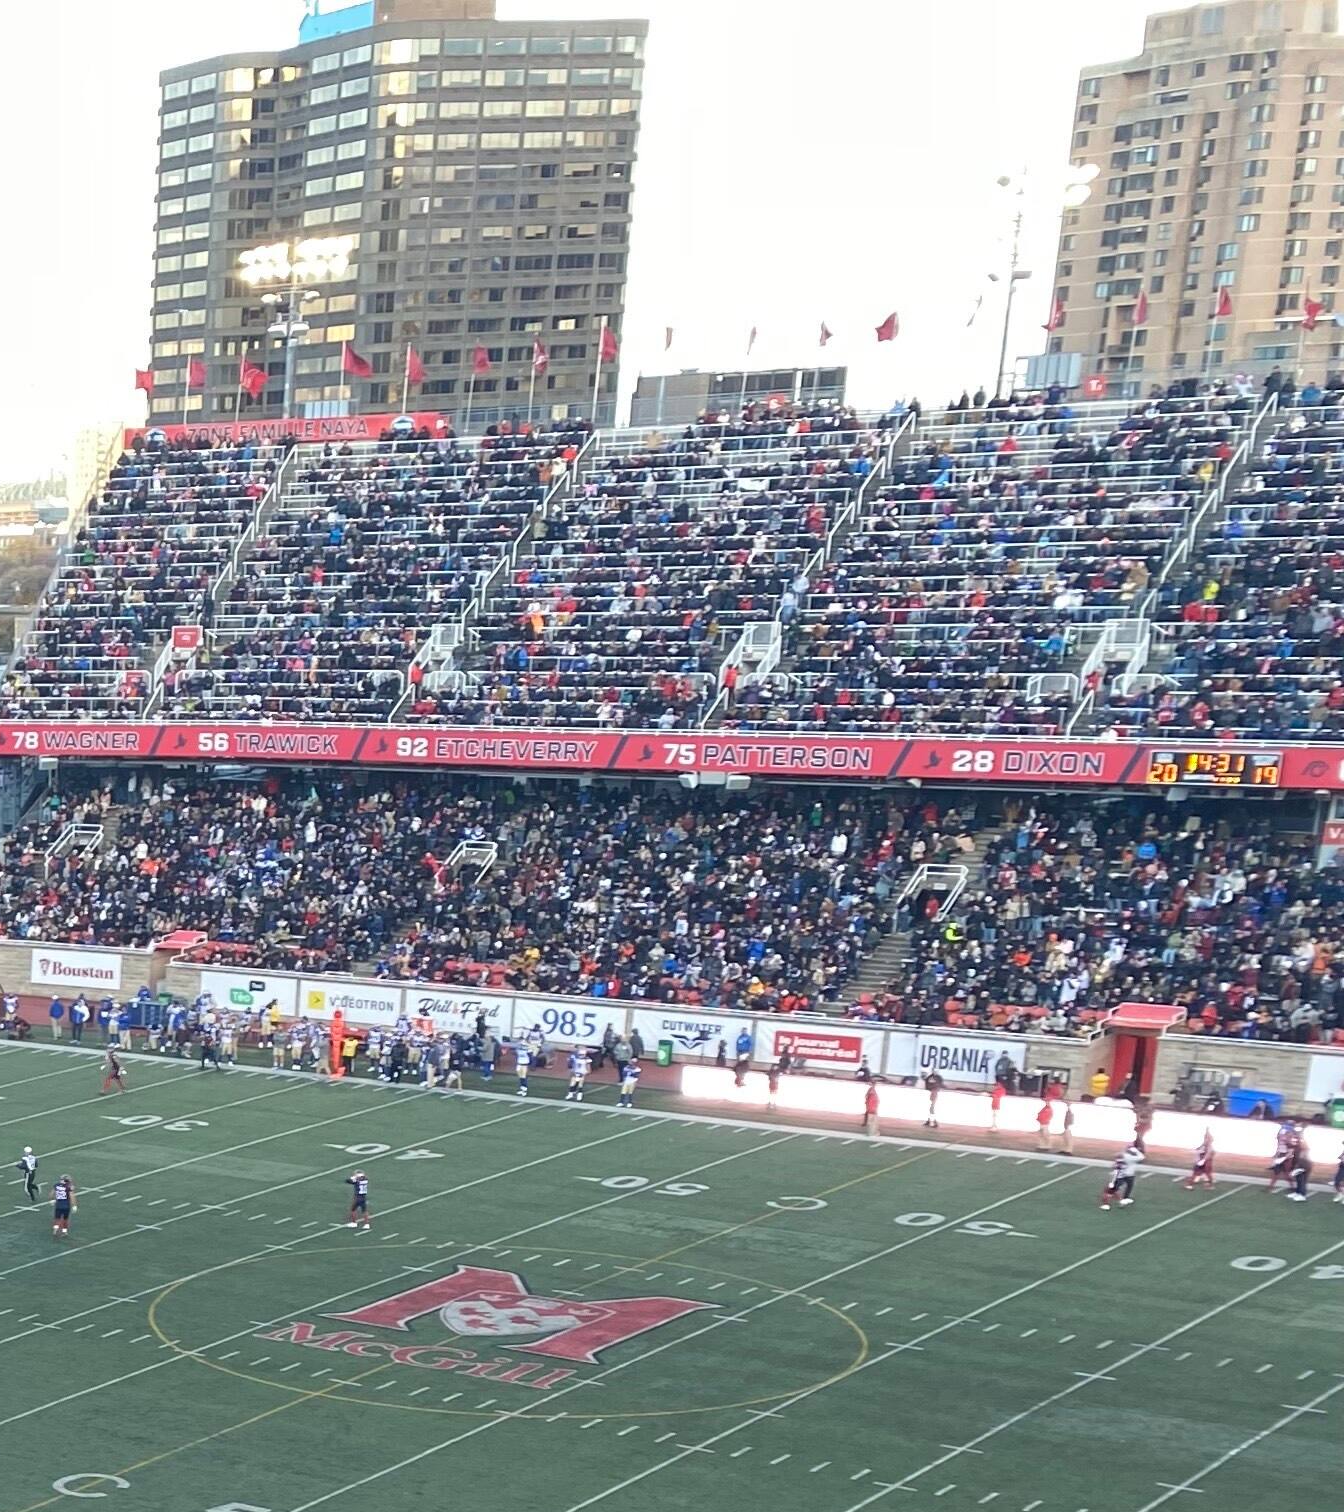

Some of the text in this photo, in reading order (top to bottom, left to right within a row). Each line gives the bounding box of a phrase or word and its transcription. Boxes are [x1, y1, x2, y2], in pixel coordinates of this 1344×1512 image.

[320, 419, 369, 436] NAYA
[12, 731, 140, 751] 78 WAGNER
[198, 732, 339, 755] 56 TRAWICK
[396, 737, 598, 763] 92 ETCHEVERRY
[663, 743, 872, 769] 75 PATTERSON
[952, 750, 1105, 776] 28 DIXON
[1184, 753, 1246, 773] 14:31
[1146, 763, 1179, 783] 20
[1253, 766, 1279, 785] 19
[52, 961, 114, 979] Boustan
[542, 1008, 597, 1038] 98.5
[662, 1020, 723, 1035] CUTWATER
[919, 1044, 990, 1074] URBANIA
[254, 1320, 579, 1390] McGill
[51, 1471, 131, 1499] C
